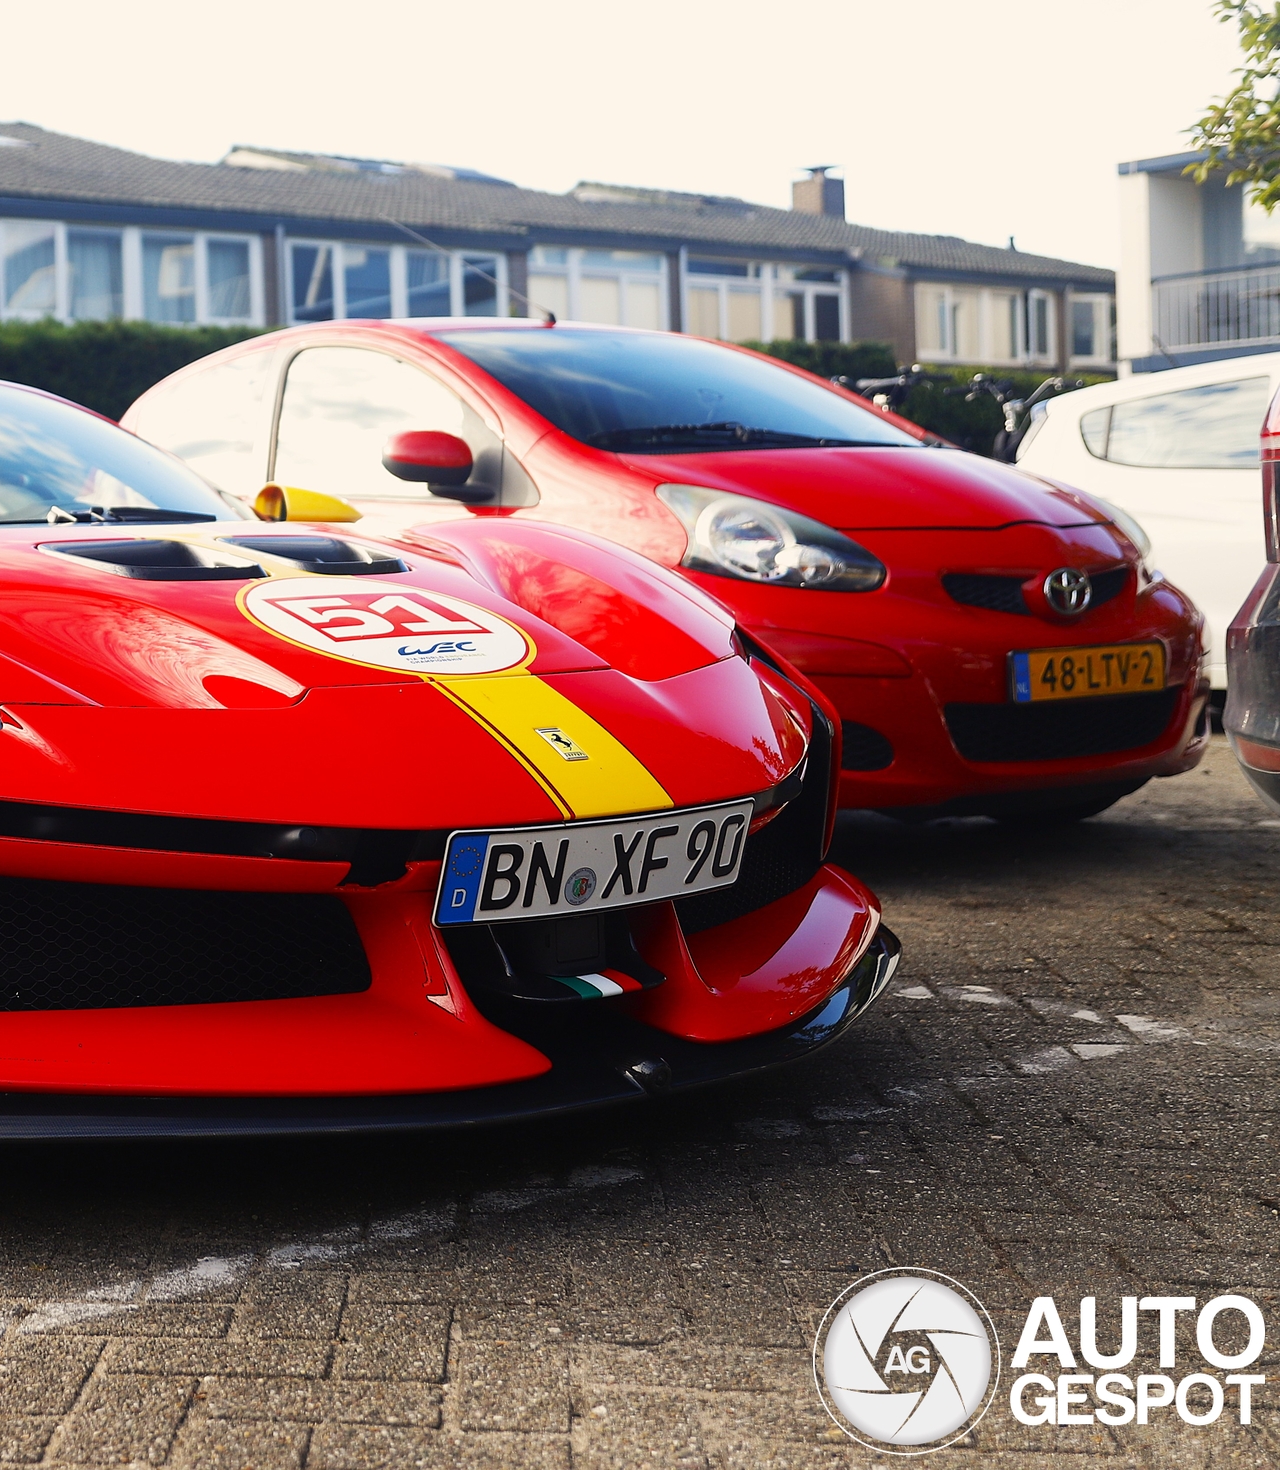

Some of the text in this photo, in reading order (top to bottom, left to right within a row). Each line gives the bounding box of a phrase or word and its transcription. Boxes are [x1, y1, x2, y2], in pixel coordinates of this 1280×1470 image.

[275, 595, 483, 639] 51
[397, 641, 477, 656] WEC
[1041, 650, 1154, 692] 48-LTV-2
[1016, 682, 1029, 694] NL
[479, 837, 570, 912] BN
[600, 824, 680, 899] XF
[683, 813, 746, 885] 90
[451, 888, 467, 908] D
